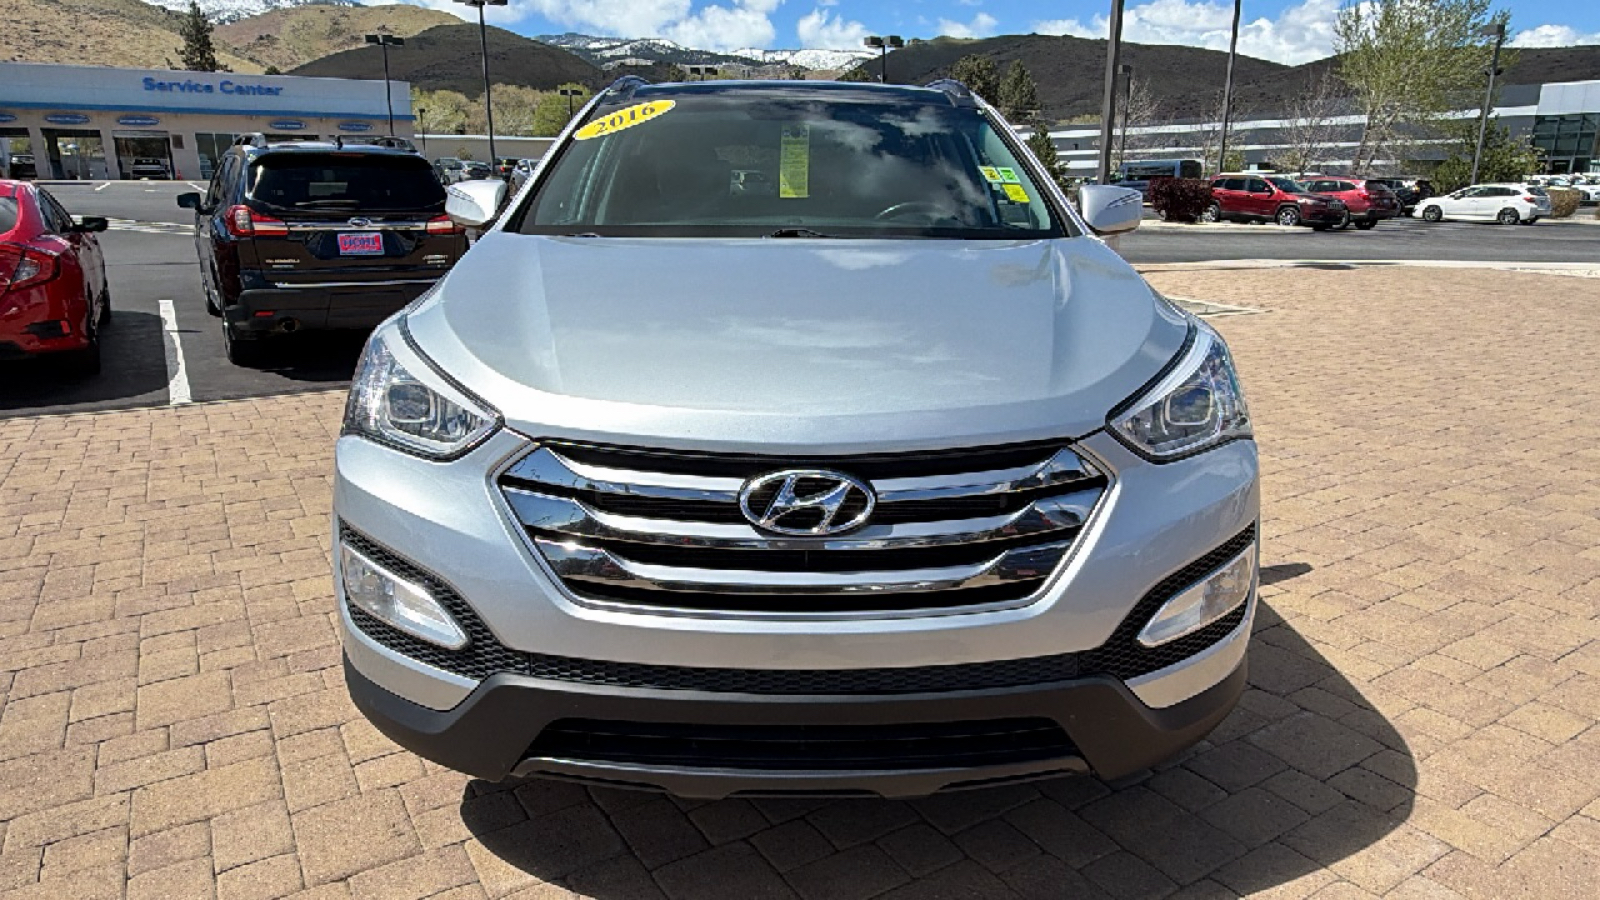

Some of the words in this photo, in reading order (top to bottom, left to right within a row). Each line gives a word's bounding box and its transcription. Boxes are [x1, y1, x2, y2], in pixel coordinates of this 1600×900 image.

[142, 76, 214, 93] Service
[219, 80, 283, 96] Center
[594, 106, 655, 135] 2016
